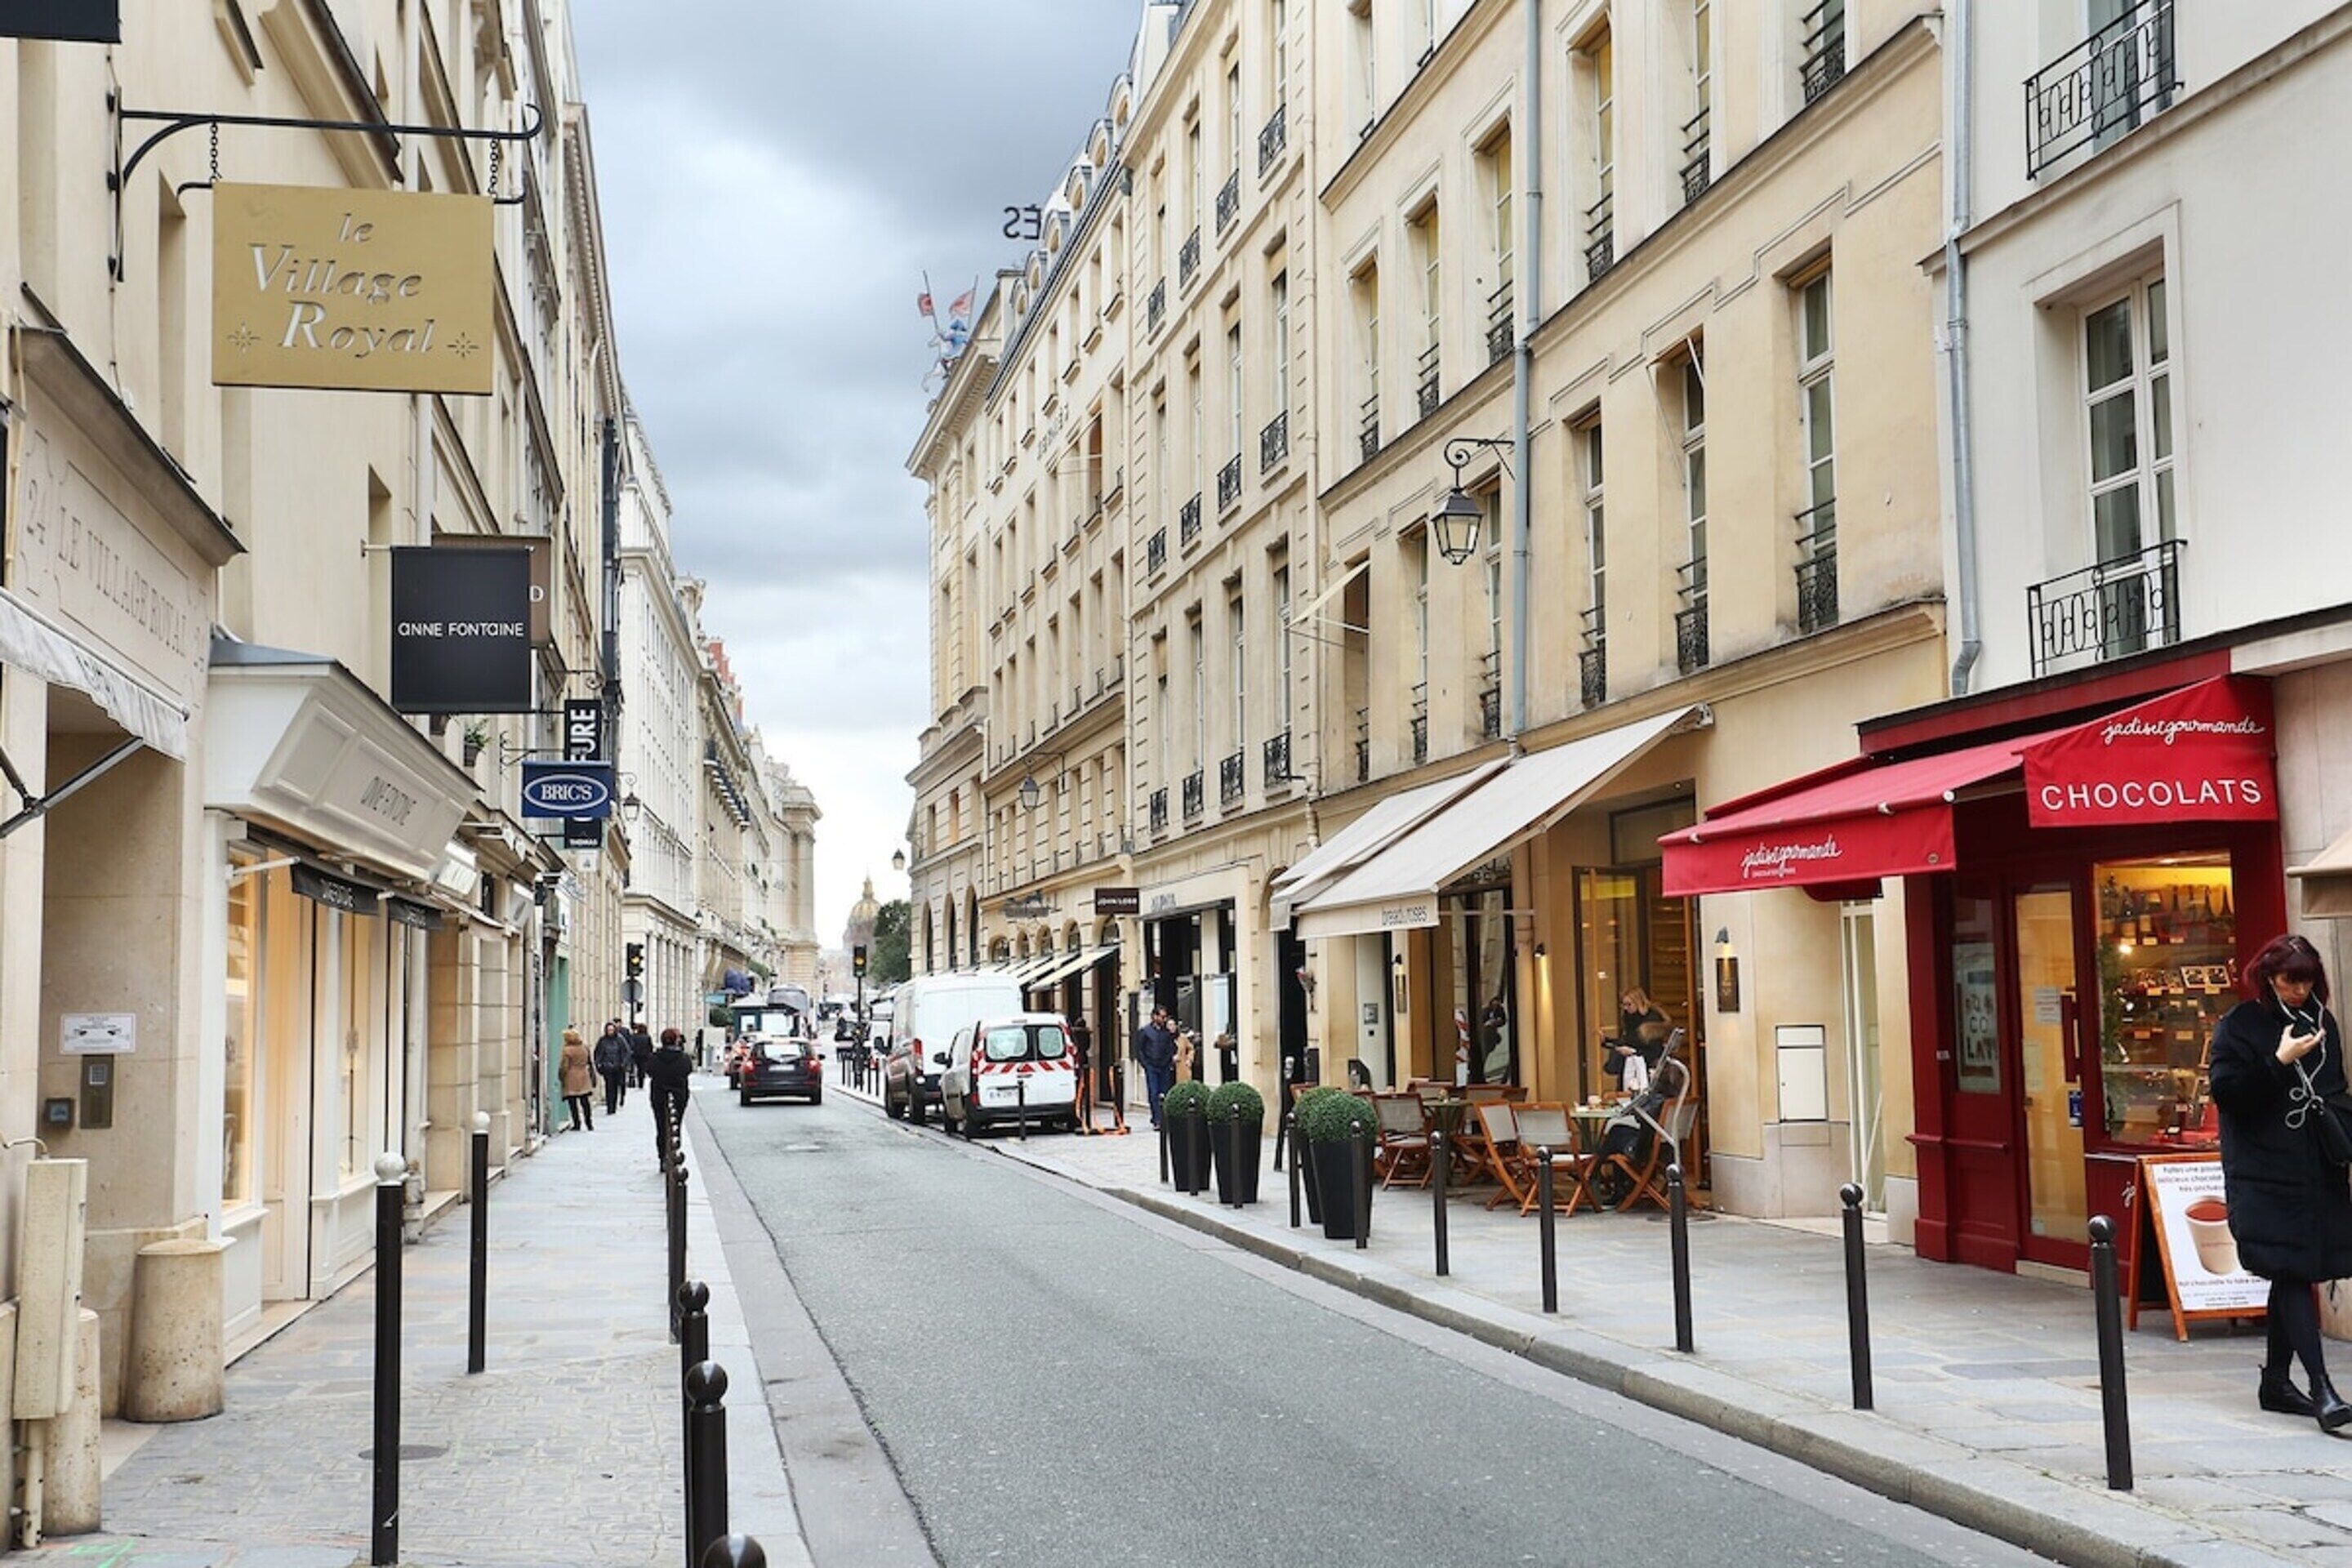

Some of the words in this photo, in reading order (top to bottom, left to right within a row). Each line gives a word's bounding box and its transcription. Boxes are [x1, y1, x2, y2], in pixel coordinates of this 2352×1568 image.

[337, 212, 375, 243] le
[247, 243, 423, 305] Village
[278, 299, 436, 359] Royal
[58, 506, 82, 571] LE
[87, 529, 149, 626] VILLAGE
[149, 587, 189, 658] ROYAL
[540, 783, 594, 801] BRIC'S
[2041, 779, 2262, 811] CHOCOLATS
